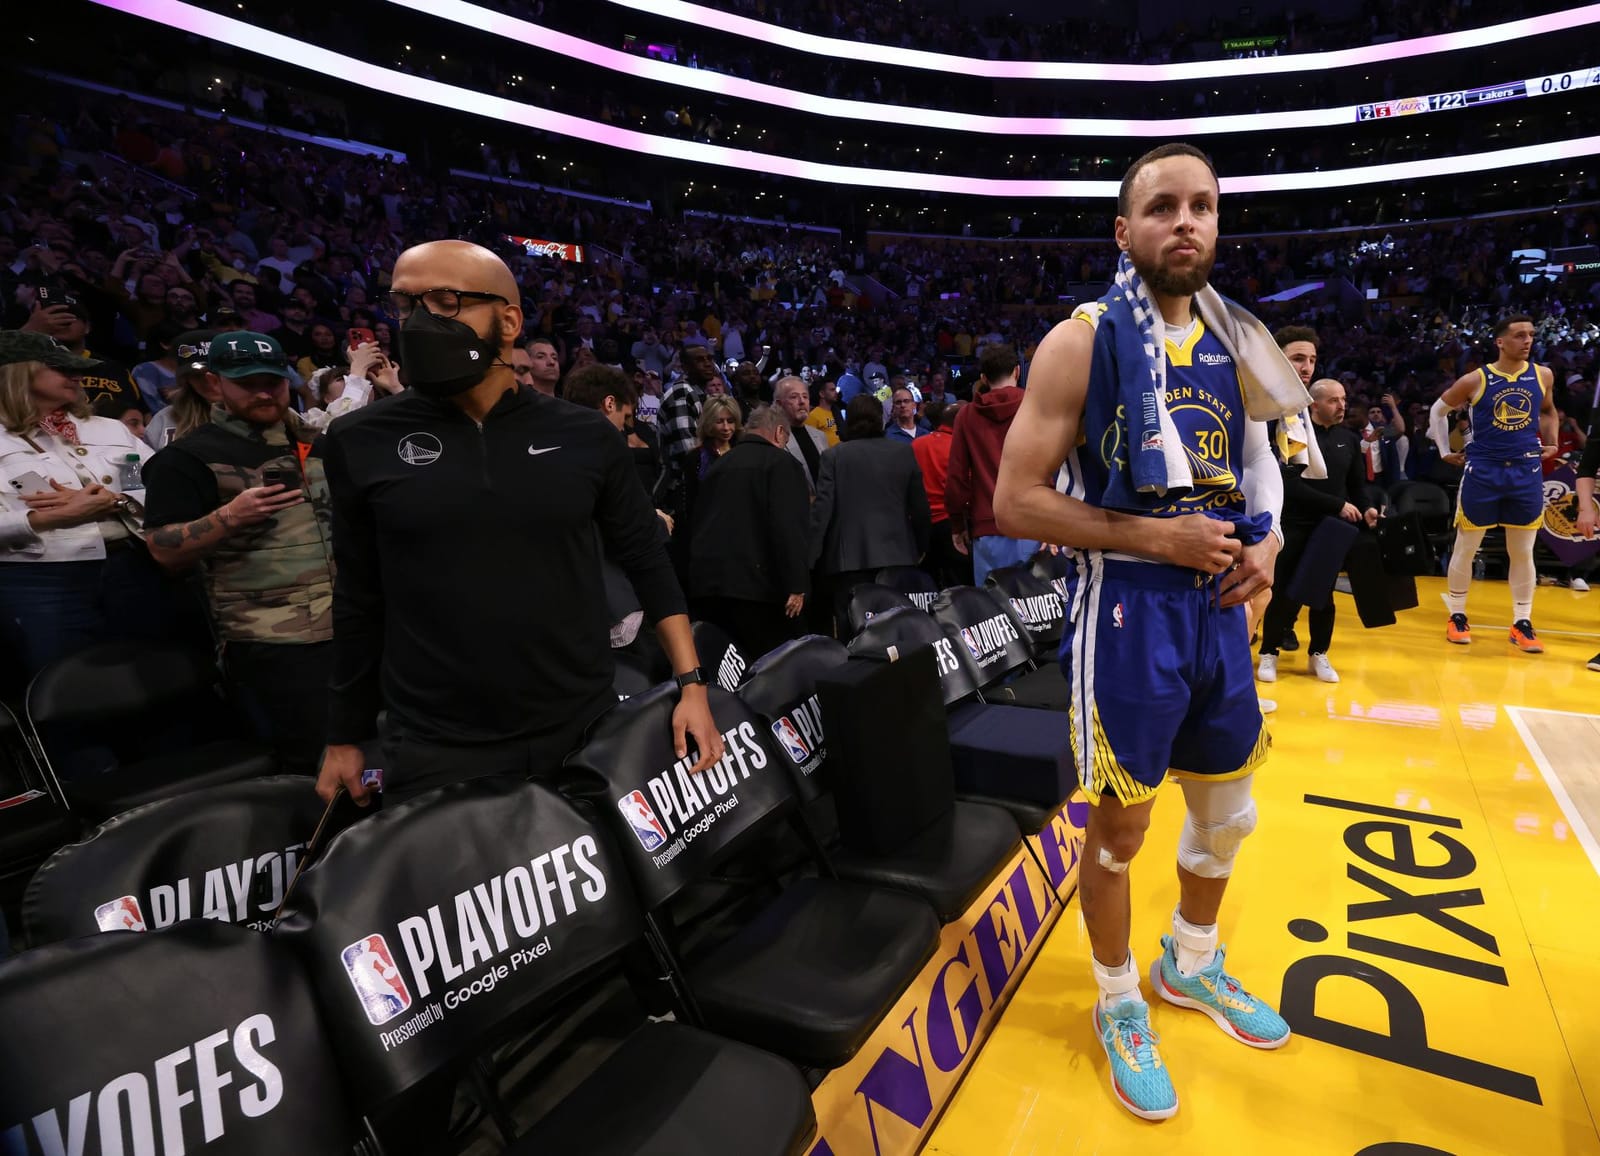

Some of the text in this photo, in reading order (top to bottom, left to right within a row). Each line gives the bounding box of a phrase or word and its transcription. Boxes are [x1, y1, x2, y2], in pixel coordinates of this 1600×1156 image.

[1432, 93, 1462, 109] 122
[1479, 88, 1514, 101] Lakers
[1541, 75, 1572, 93] 0.0
[1199, 353, 1231, 364] Rakuten
[1165, 387, 1233, 421] DEN STATE
[1519, 400, 1526, 408] 7
[1195, 430, 1225, 460] 30
[970, 613, 1019, 654] PLAYOFFS
[648, 721, 767, 834] PLAYOFFS
[683, 810, 716, 843] Google
[714, 794, 739, 818] Pixel
[398, 835, 607, 999] PLAYOFFS
[1279, 793, 1543, 1106] Pixel
[379, 1005, 435, 1051] Presented
[444, 965, 509, 1010] Google
[510, 936, 552, 971] Pixel
